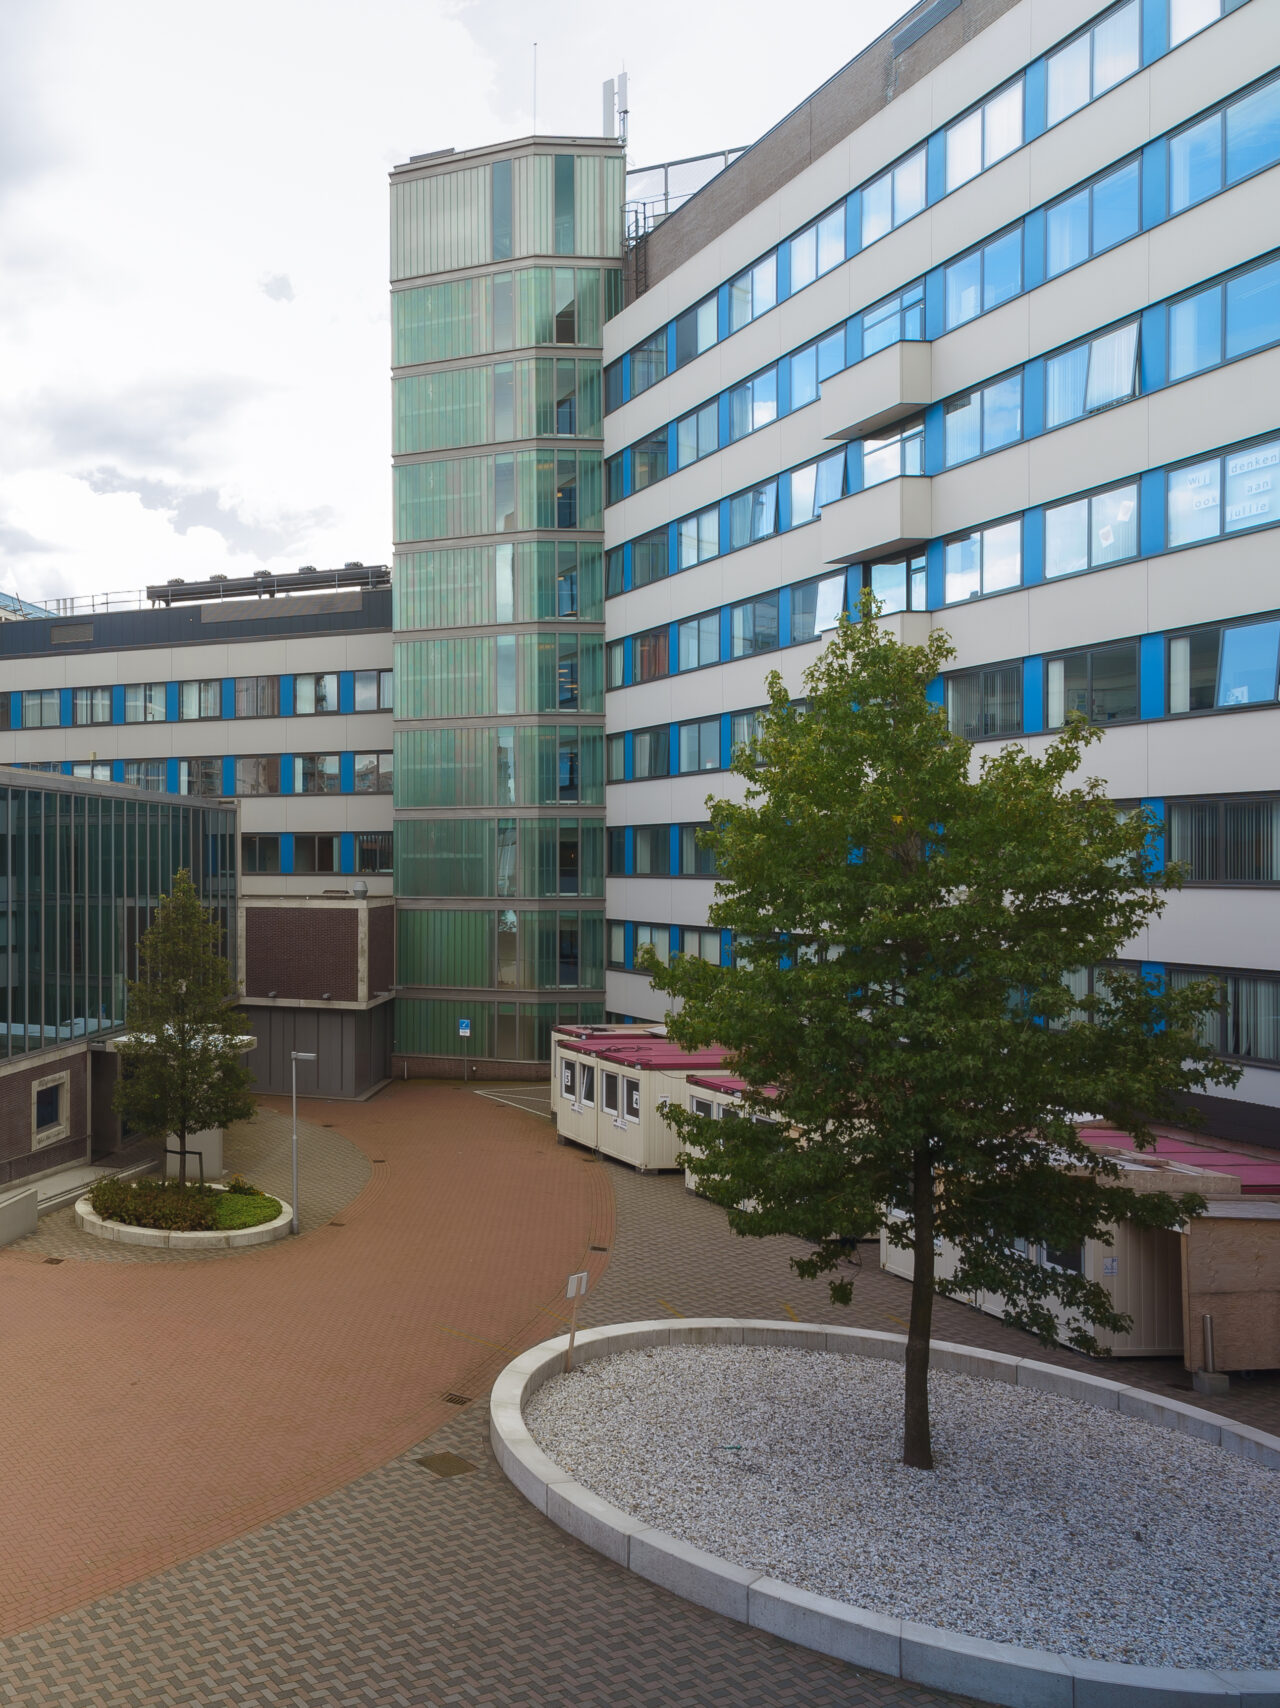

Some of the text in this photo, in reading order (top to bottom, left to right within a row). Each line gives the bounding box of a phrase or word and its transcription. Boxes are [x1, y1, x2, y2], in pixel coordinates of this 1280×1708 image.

[1231, 455, 1277, 473] denken
[1248, 480, 1269, 493] aan
[1194, 496, 1217, 508] ook
[1230, 503, 1267, 519] jullie
